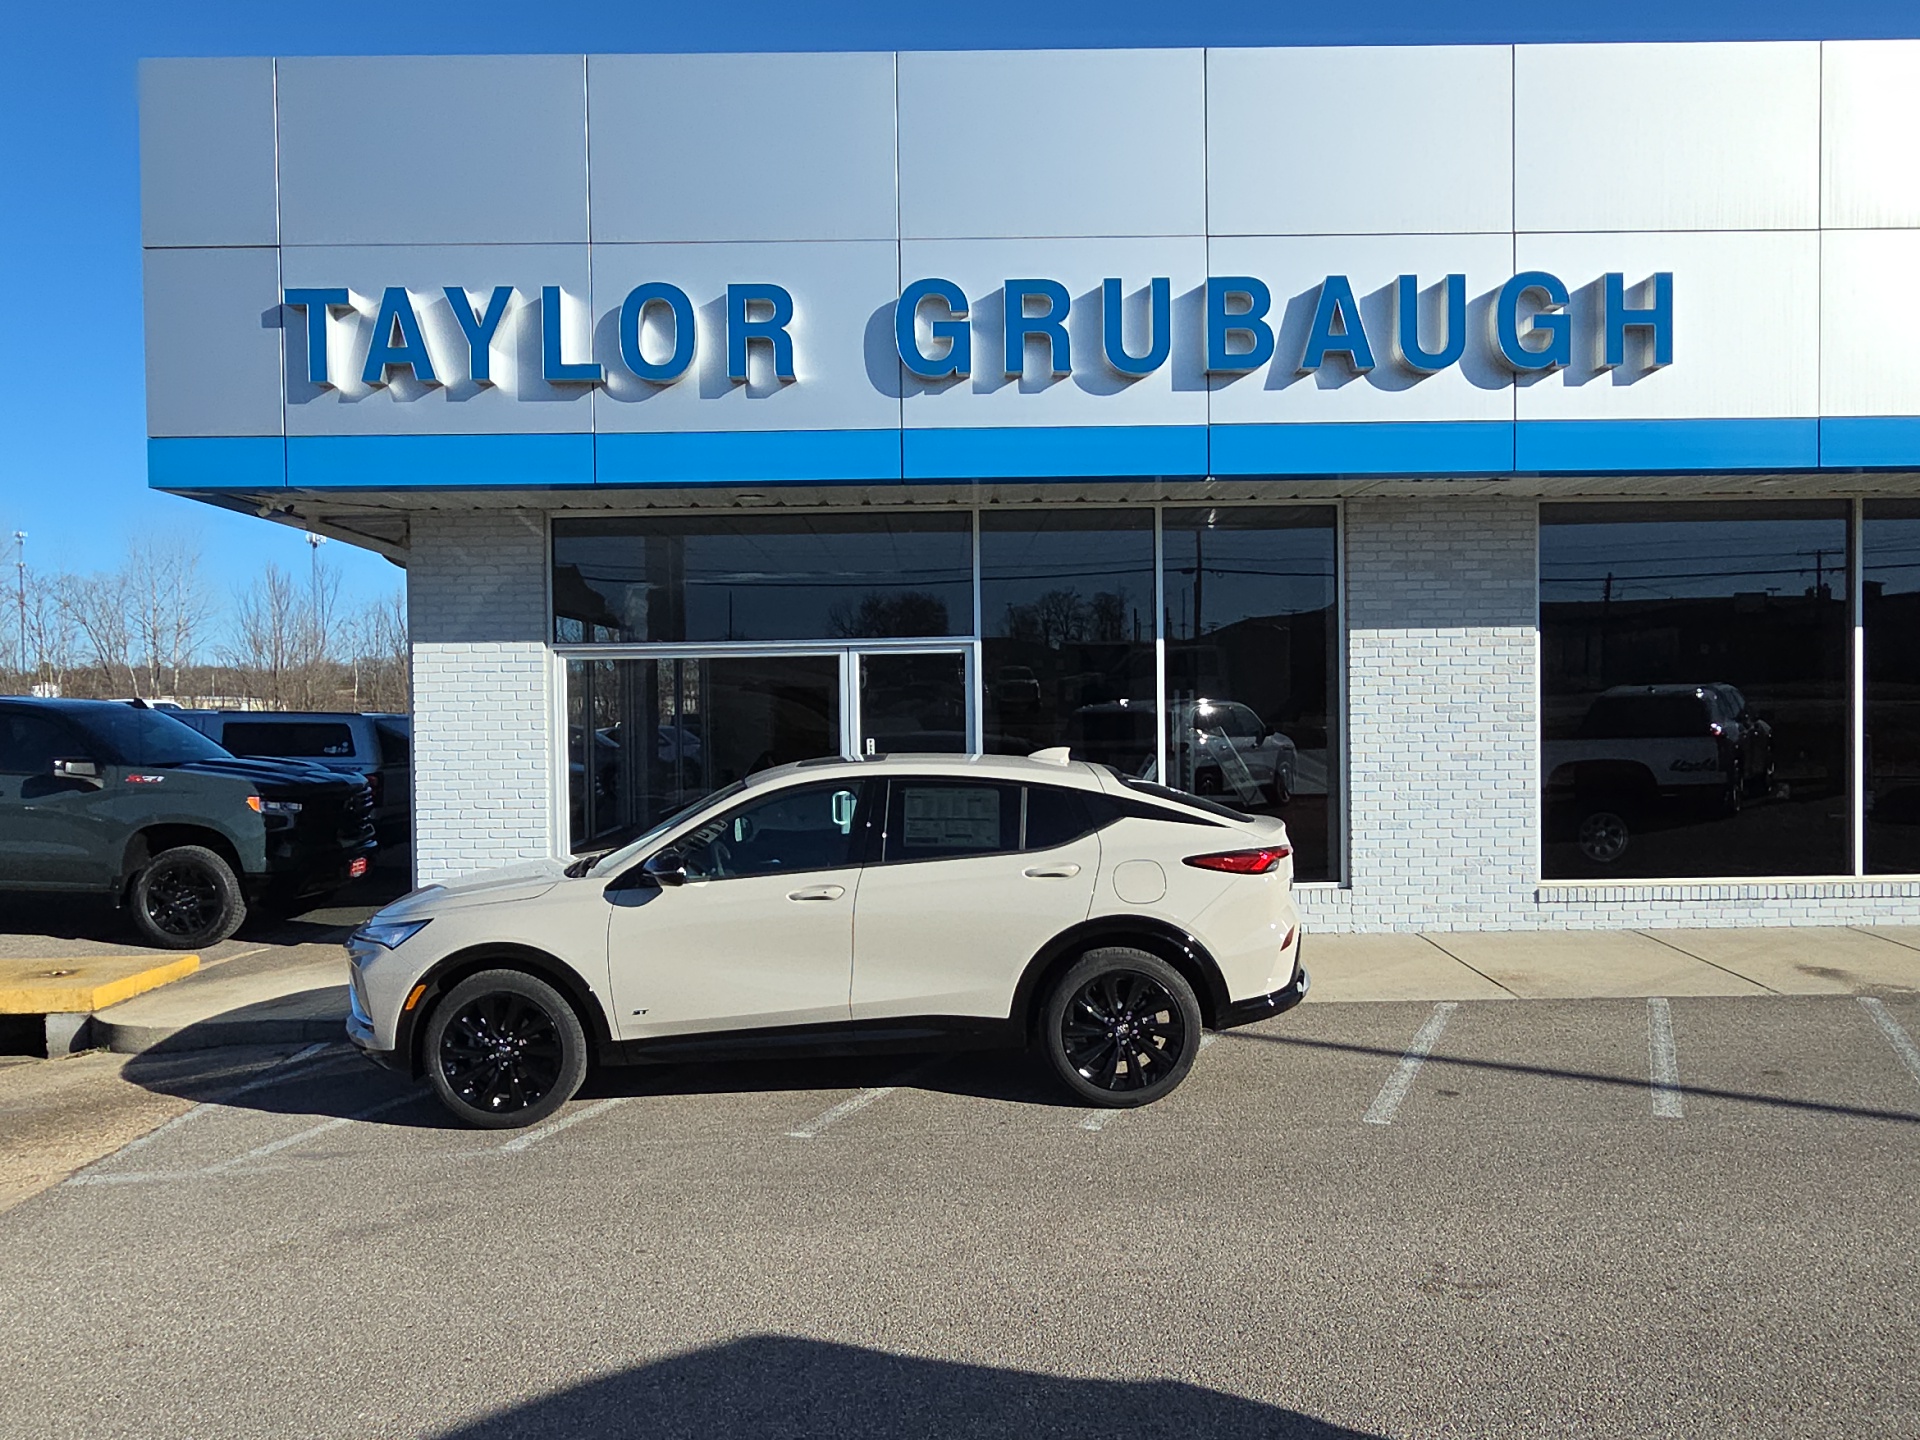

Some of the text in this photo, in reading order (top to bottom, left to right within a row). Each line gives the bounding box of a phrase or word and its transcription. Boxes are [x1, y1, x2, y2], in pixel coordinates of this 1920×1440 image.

[285, 271, 1673, 388] TAYLOR GRUBAUGH
[631, 1008, 650, 1016] ST
